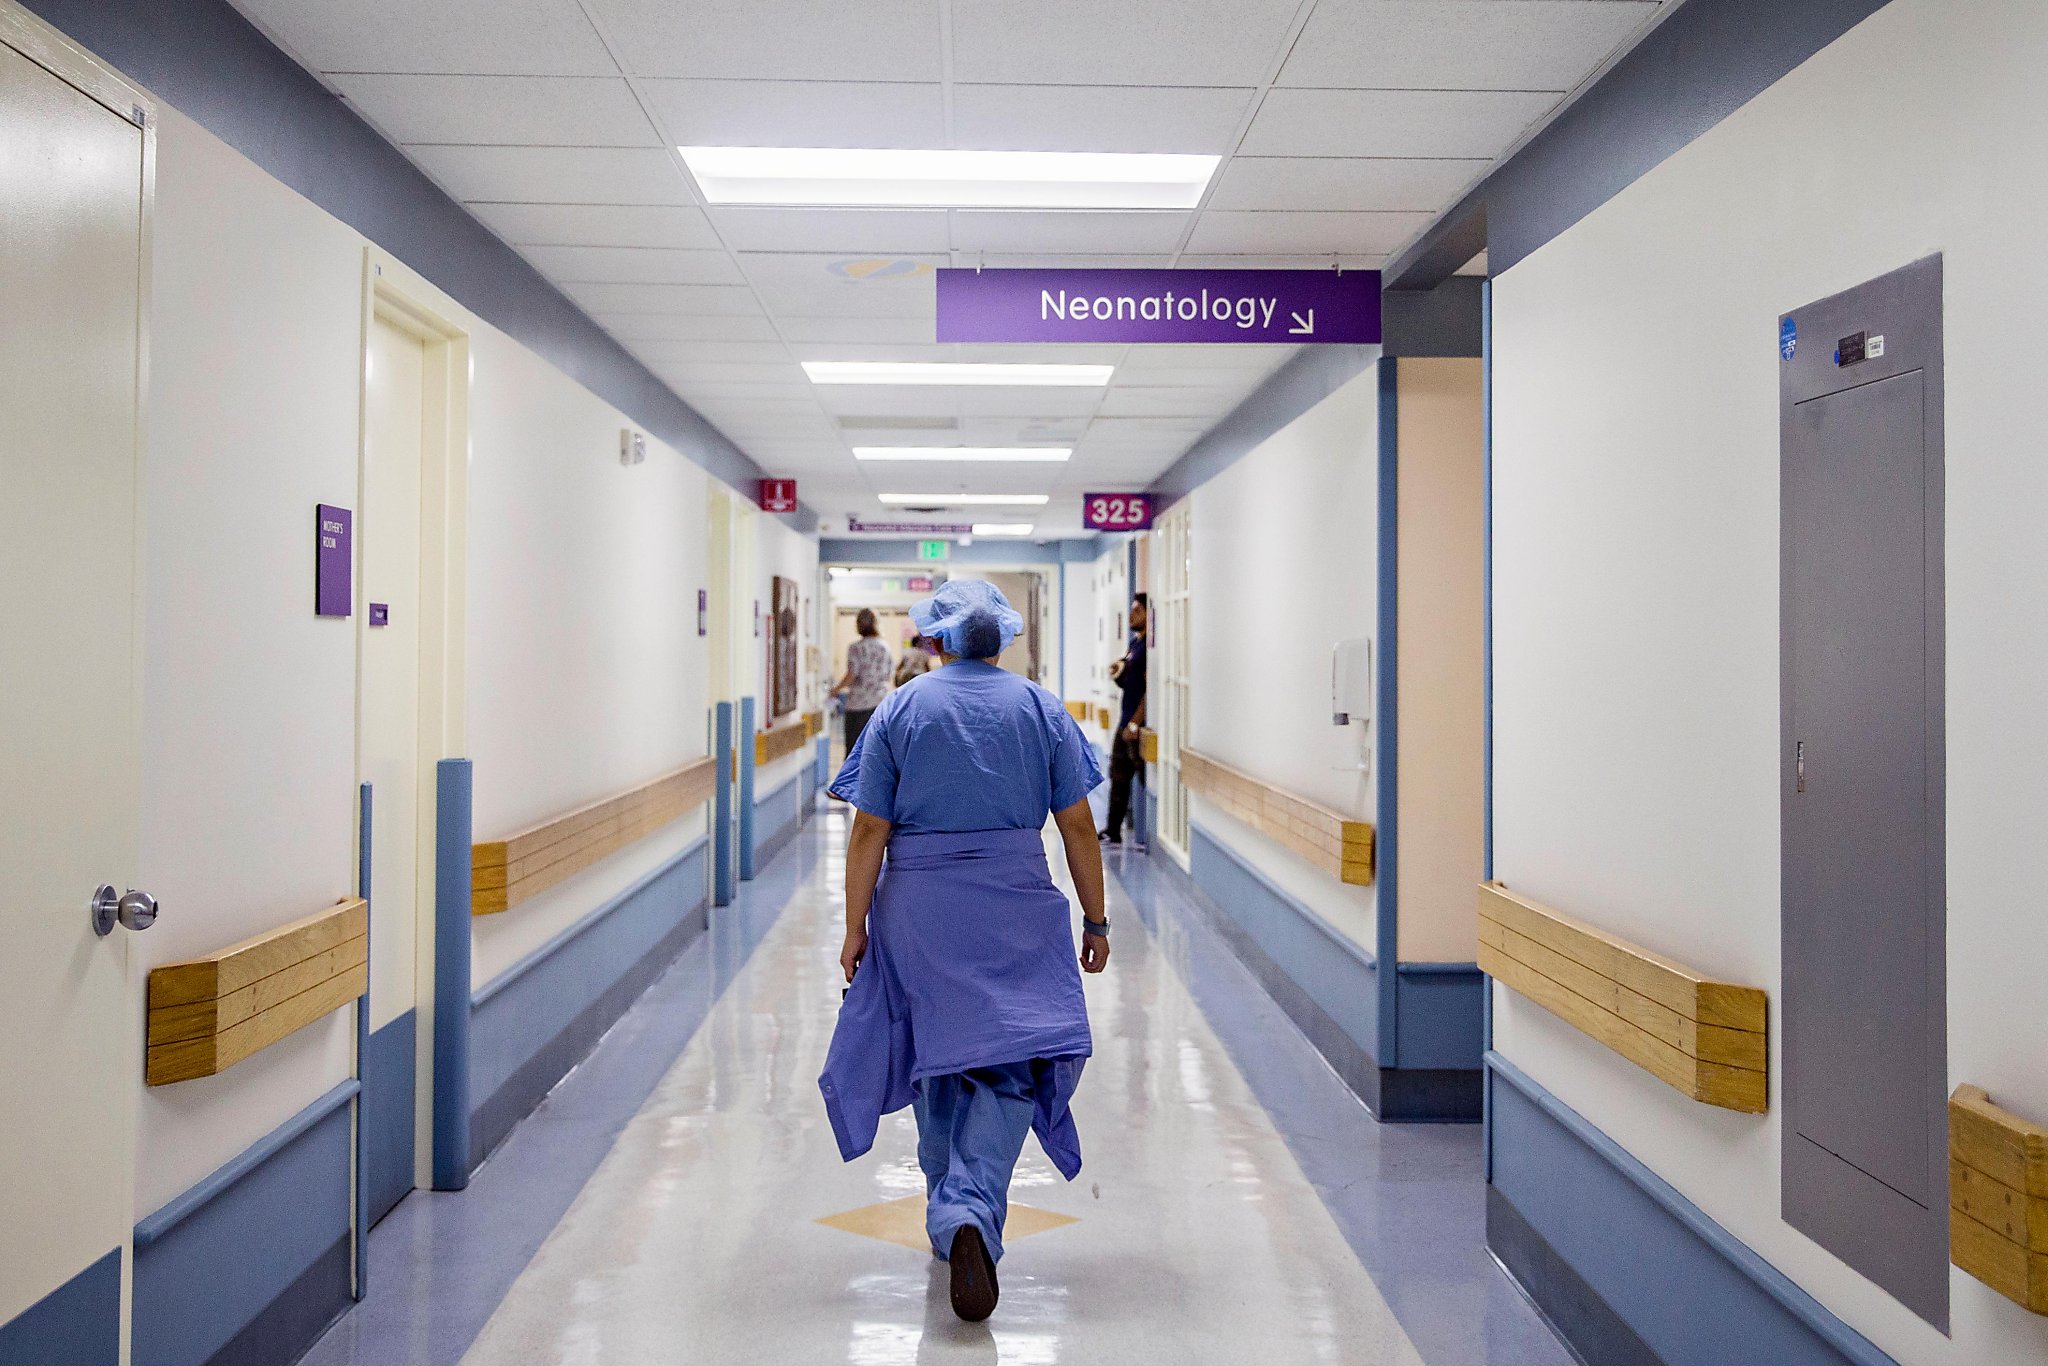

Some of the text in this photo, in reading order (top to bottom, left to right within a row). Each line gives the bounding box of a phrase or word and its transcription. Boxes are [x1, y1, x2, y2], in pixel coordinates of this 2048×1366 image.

[1041, 288, 1277, 328] Neonatology
[1091, 498, 1144, 523] 325
[322, 535, 336, 548] ROOM
